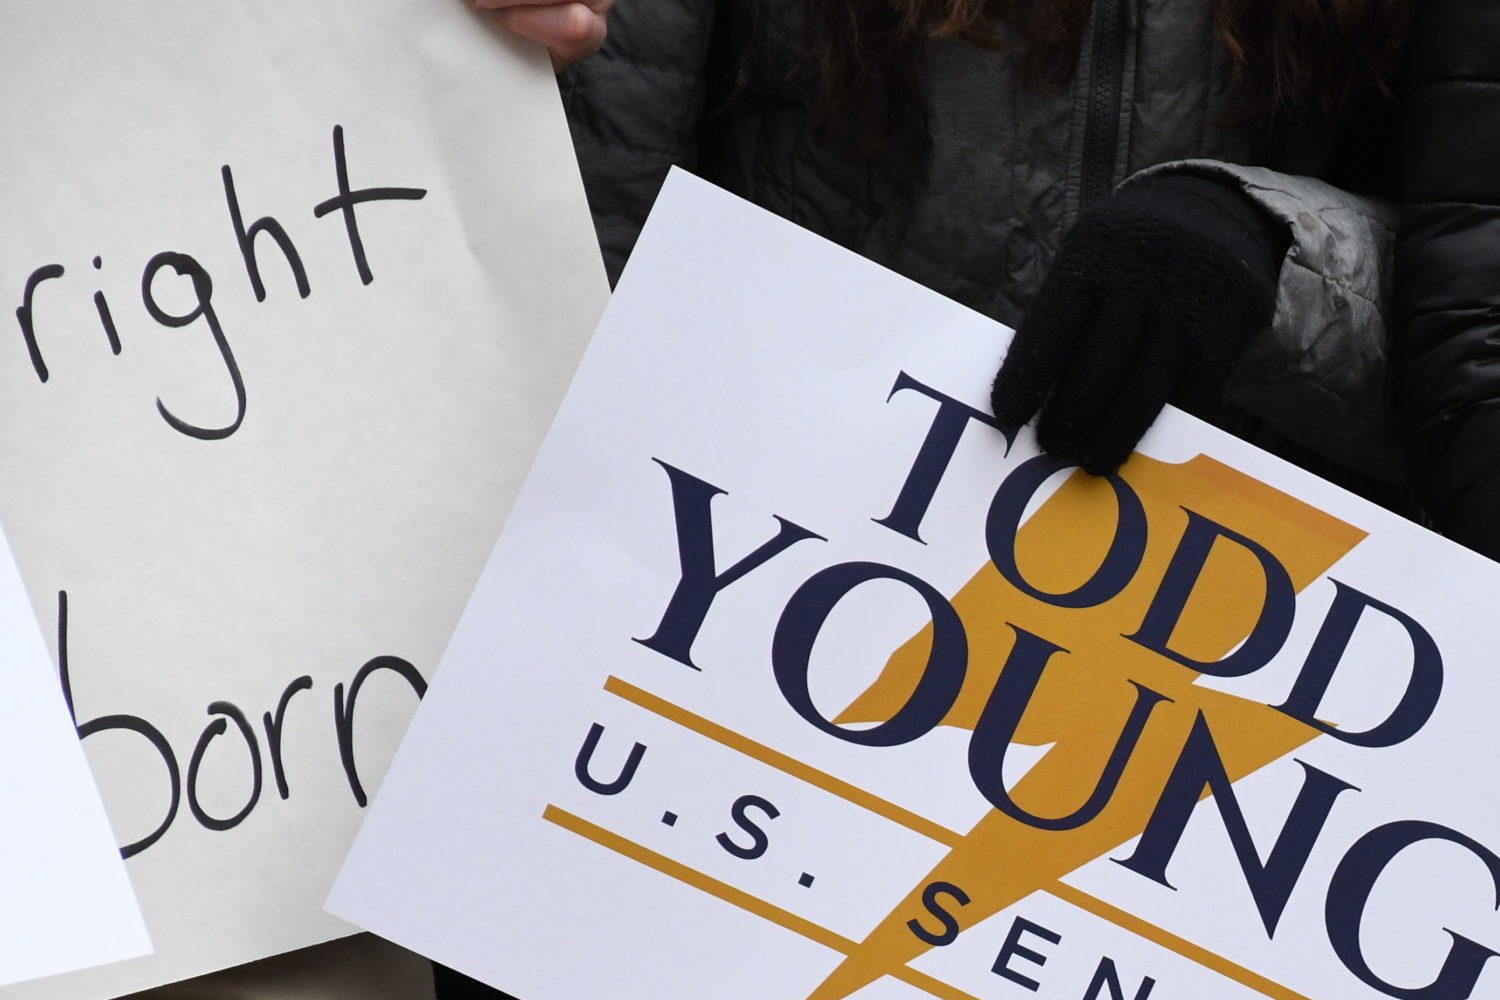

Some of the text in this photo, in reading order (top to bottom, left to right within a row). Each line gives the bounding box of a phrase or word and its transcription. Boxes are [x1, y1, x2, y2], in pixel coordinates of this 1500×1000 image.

[16, 125, 427, 440] right
[871, 370, 1444, 748] TODD
[574, 722, 817, 890] U.S.
